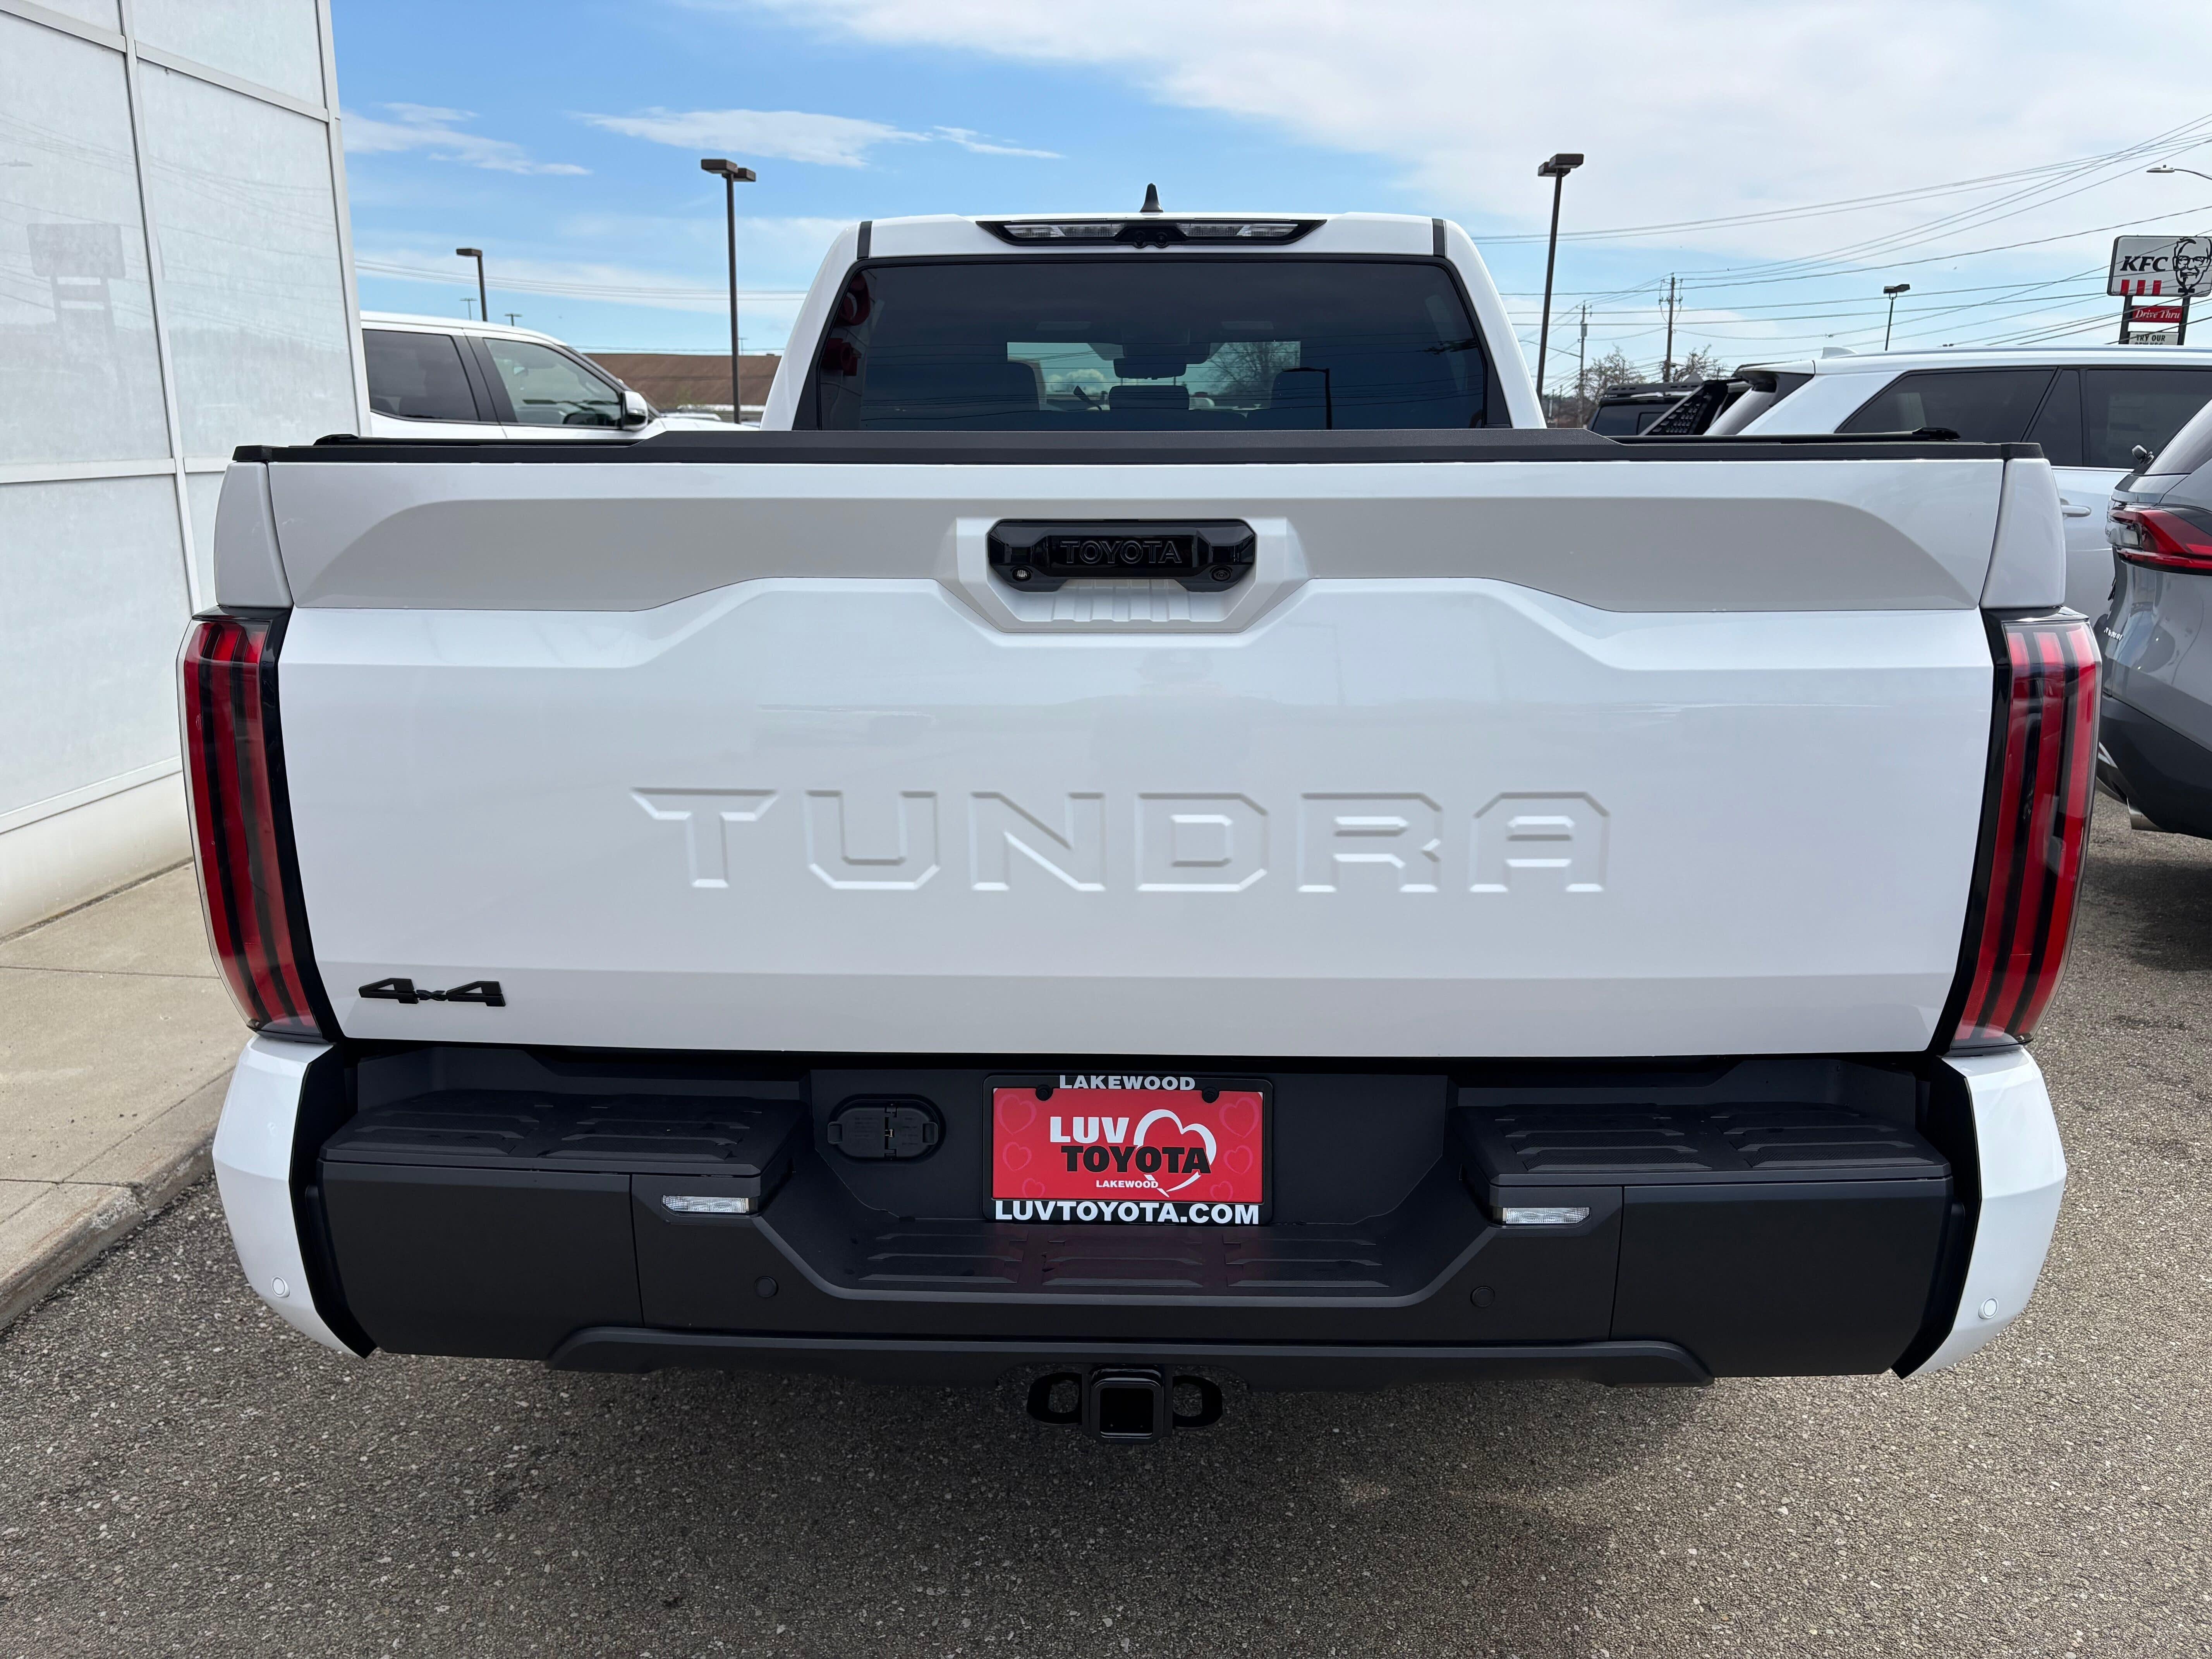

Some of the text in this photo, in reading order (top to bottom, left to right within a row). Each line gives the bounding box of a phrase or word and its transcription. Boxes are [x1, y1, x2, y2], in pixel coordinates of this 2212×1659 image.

[2120, 256, 2168, 271] KFC
[2135, 309, 2179, 319] Drive Thru
[1060, 540, 1182, 564] TOYOTA
[629, 787, 1612, 893] TUNDRA
[1060, 1075, 1195, 1091] LAKEWOOD
[1050, 1116, 1129, 1143] LUV
[1061, 1146, 1211, 1173] TOYOTA
[1096, 1180, 1159, 1188] LAKEWOOD
[995, 1200, 1259, 1224] LUVTOYOTA.COM
